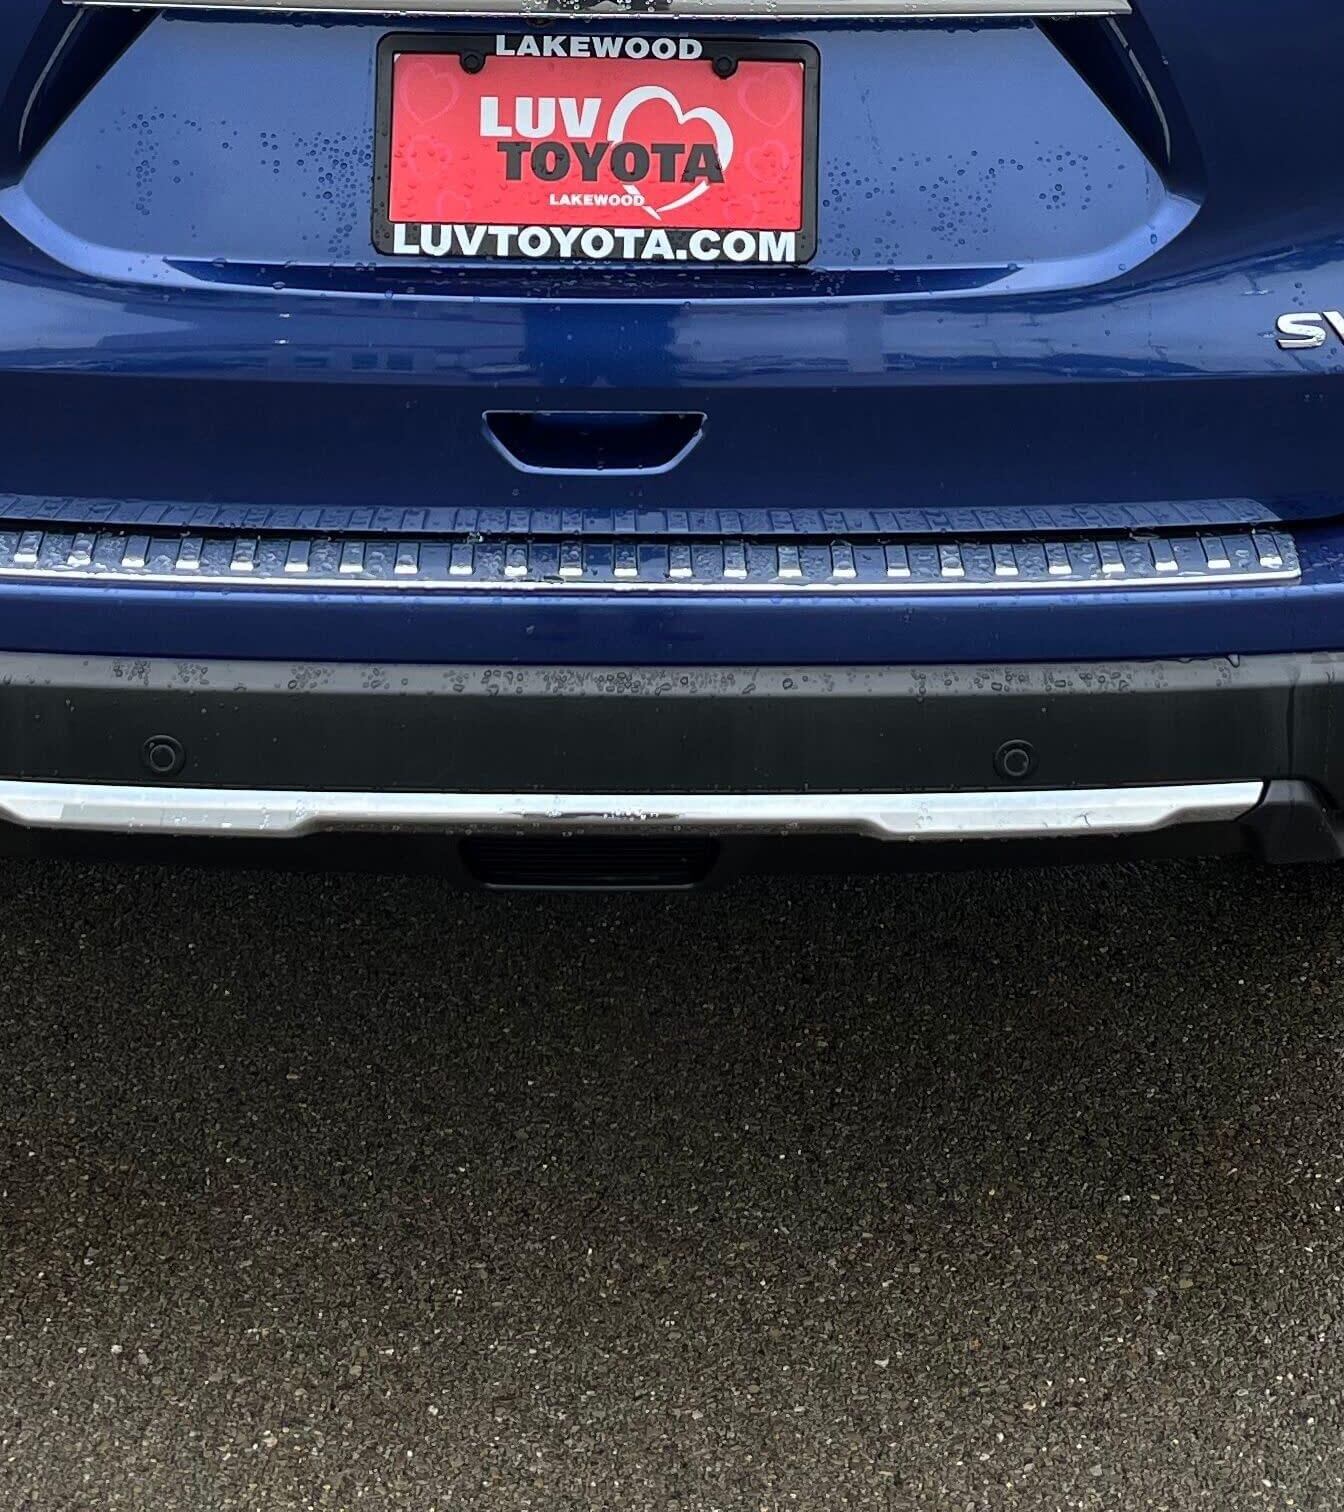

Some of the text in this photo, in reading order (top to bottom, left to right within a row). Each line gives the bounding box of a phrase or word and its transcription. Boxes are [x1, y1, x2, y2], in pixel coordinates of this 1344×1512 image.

[495, 34, 703, 60] LAKEWOOD
[479, 96, 602, 138] LUV
[497, 141, 726, 184] TOYOTA
[549, 193, 645, 207] LAKEWOOD
[393, 223, 796, 263] LUVTOYOTA.COM
